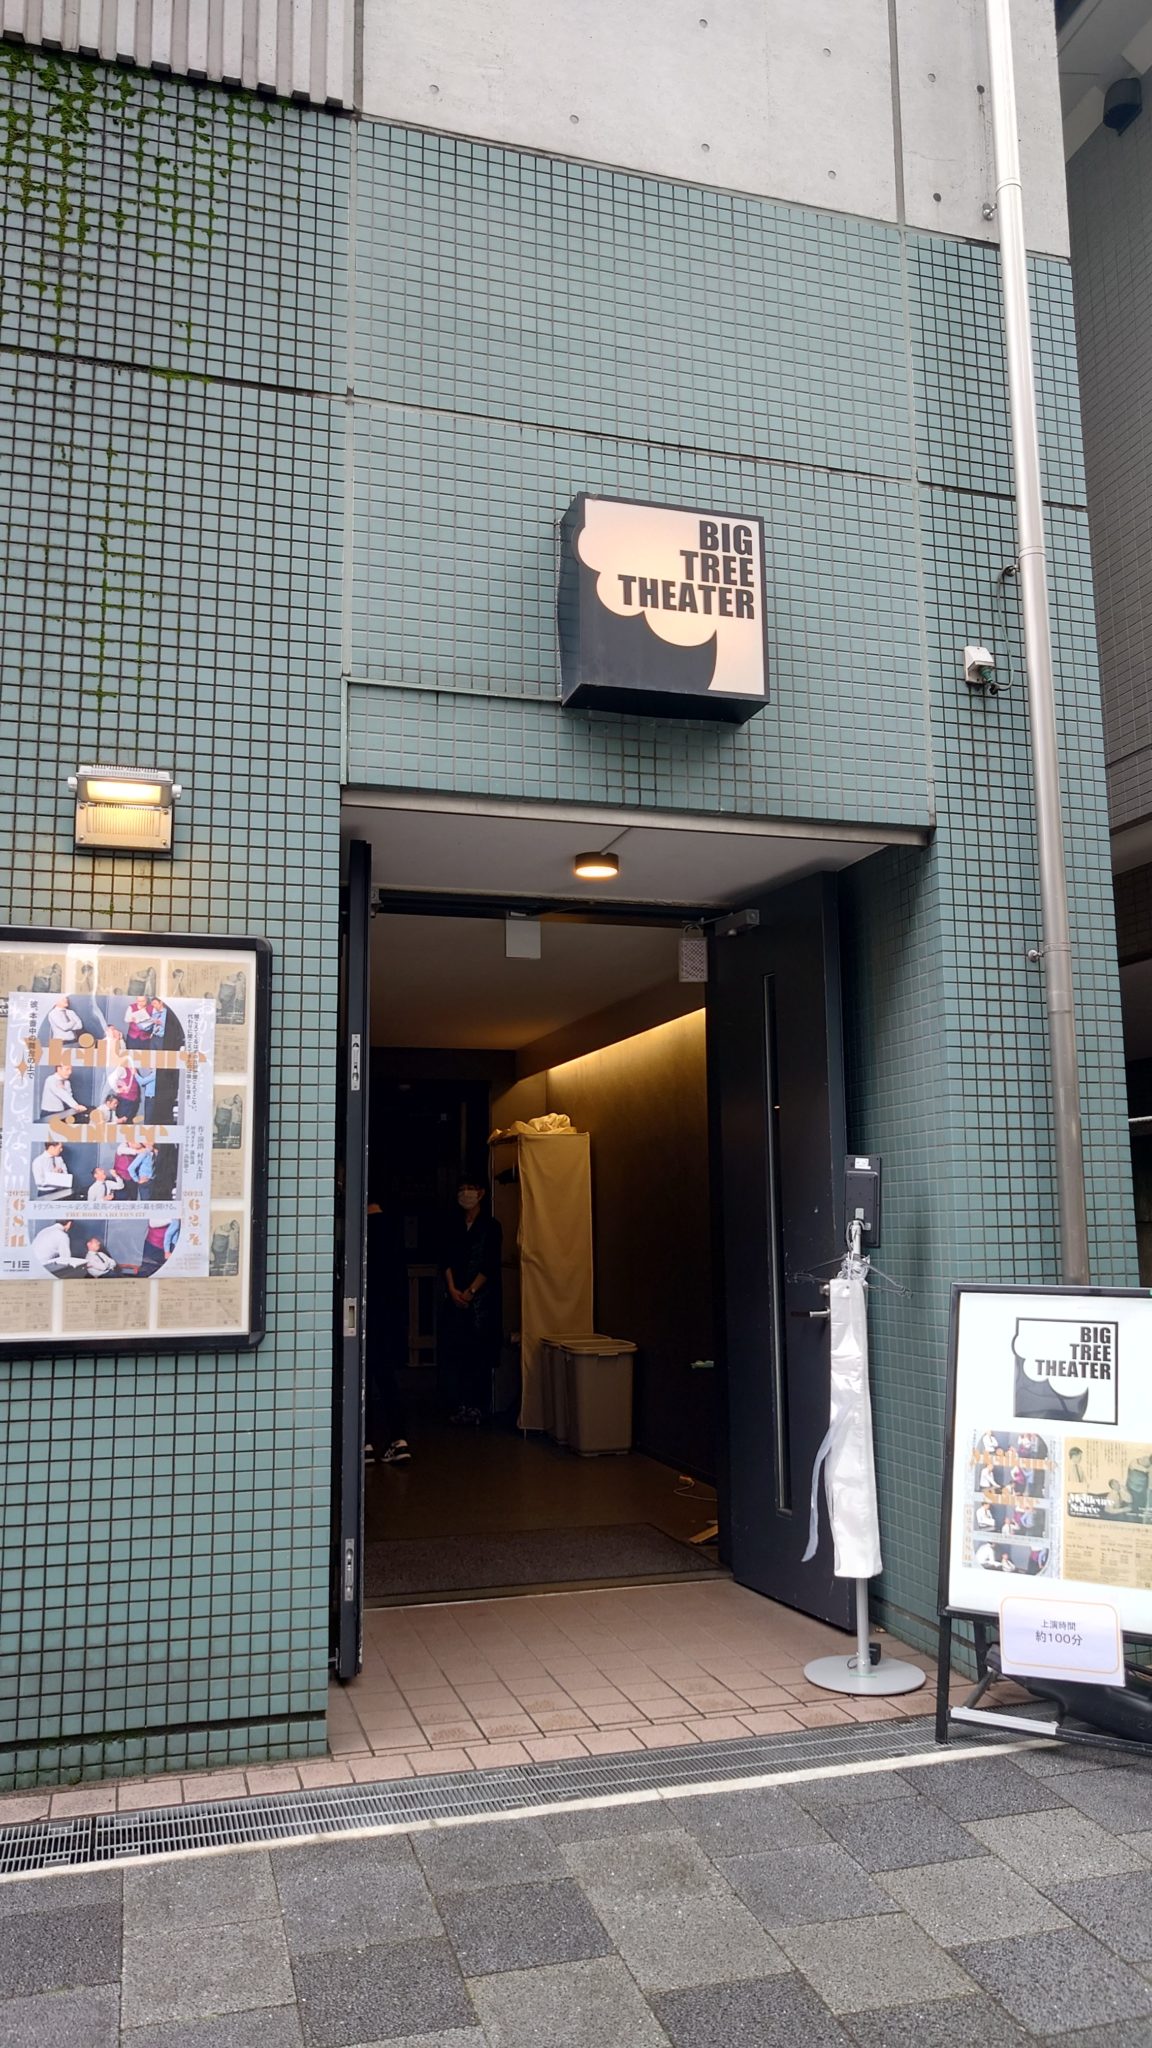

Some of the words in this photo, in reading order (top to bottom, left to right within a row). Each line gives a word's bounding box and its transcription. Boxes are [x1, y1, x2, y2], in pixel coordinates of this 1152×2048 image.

[699, 520, 753, 556] BIG
[679, 549, 755, 588] TREE
[617, 574, 755, 620] THEATER
[1080, 1326, 1111, 1344] BIG
[1069, 1343, 1111, 1362] TREE
[1035, 1359, 1111, 1380] THEATER
[1041, 1619, 1076, 1632] 上演時間
[1035, 1630, 1083, 1646] 約100分
